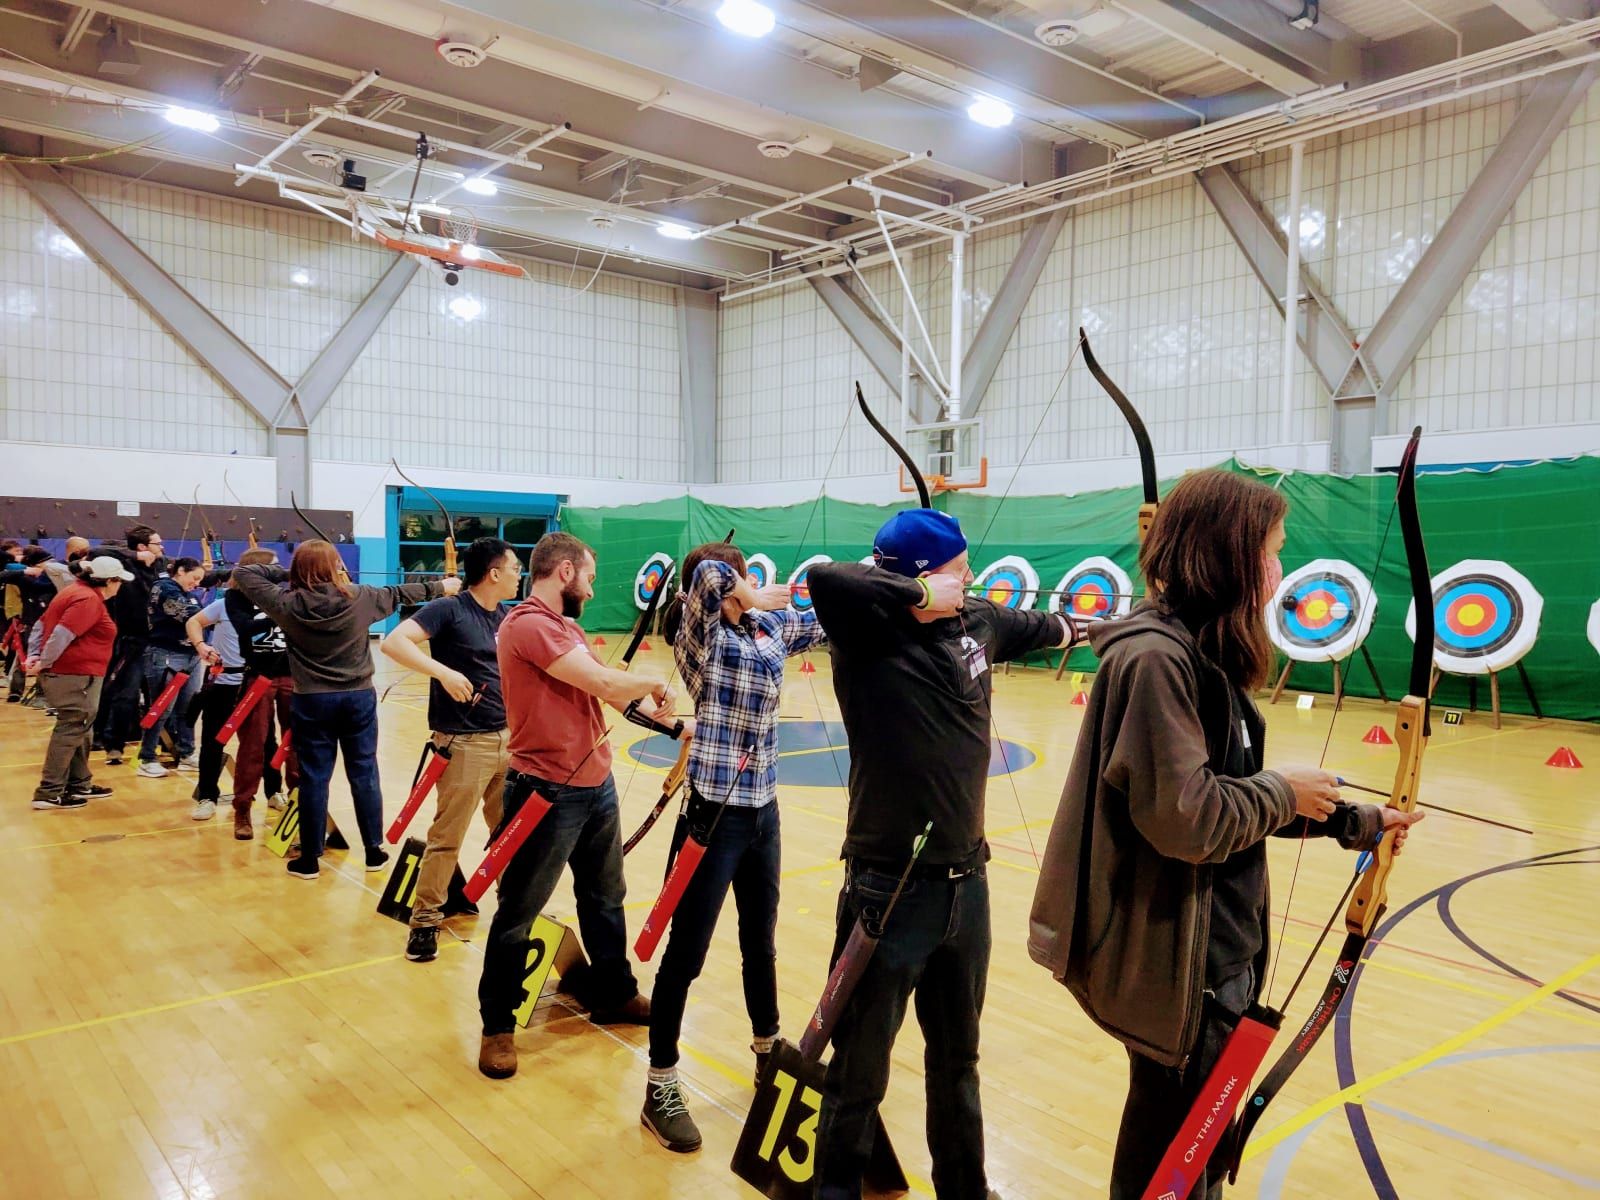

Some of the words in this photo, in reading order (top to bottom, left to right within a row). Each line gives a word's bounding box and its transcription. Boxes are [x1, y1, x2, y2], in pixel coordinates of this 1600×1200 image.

[274, 799, 299, 842] 10
[1316, 1004, 1333, 1025] THE
[1328, 987, 1341, 1004] ON
[1301, 999, 1326, 1037] ARCHERY
[1296, 1025, 1320, 1053] MARK
[758, 1069, 823, 1183] 13
[1184, 1141, 1199, 1163] ON
[1196, 1115, 1215, 1140] THE
[1211, 1075, 1238, 1115] MARK
